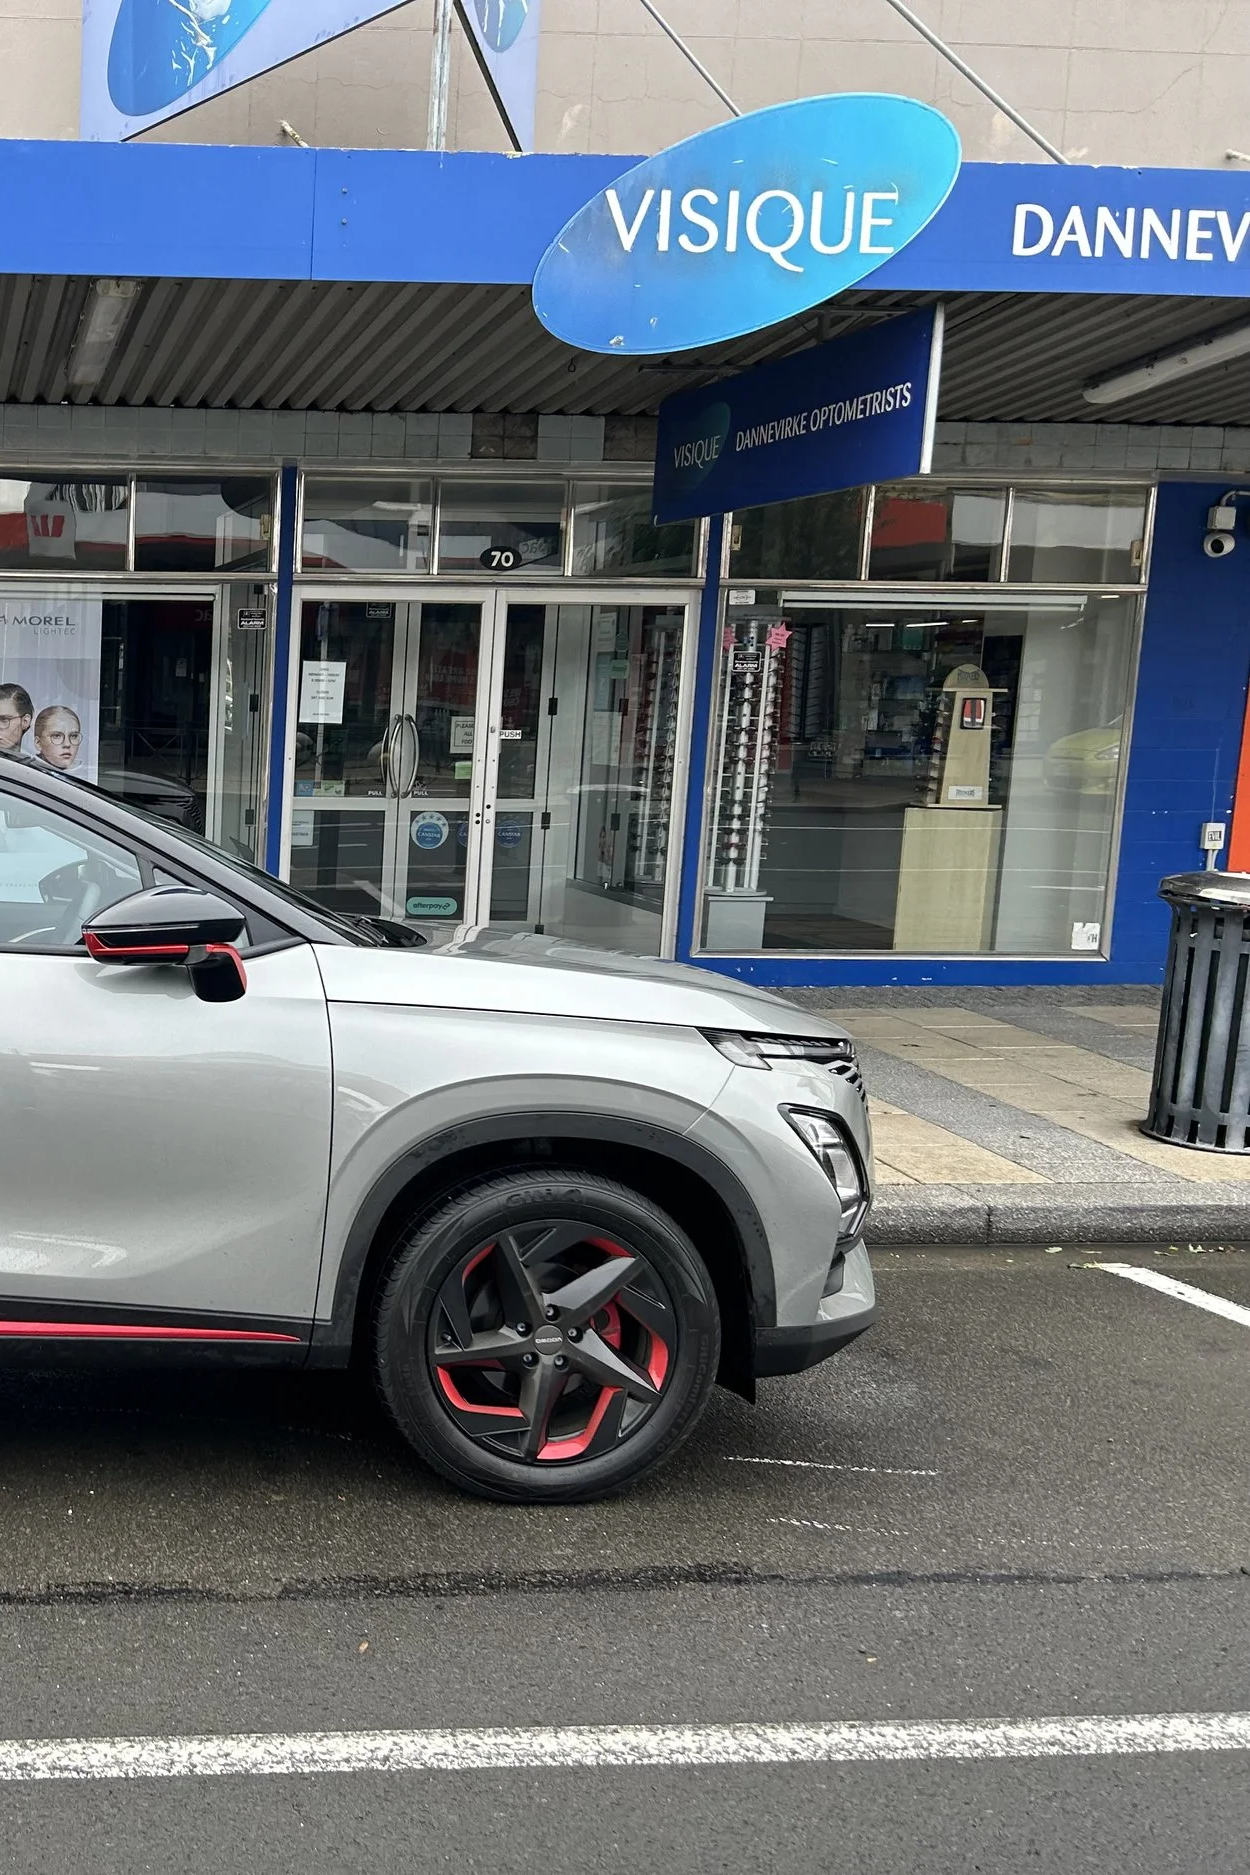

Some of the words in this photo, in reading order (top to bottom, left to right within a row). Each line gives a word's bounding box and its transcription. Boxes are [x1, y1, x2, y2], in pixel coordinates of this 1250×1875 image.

[606, 188, 894, 271] VISIQUE
[1012, 203, 1250, 262] DANNEV
[674, 435, 720, 469] VISIQUE
[736, 408, 806, 451] DANNEVIRKE
[810, 381, 911, 431] OPTOMETRISTS
[490, 551, 514, 567] 70
[12, 616, 76, 626] MOREL
[34, 627, 76, 636] LIGHTEC
[499, 730, 521, 738] PUSH
[412, 902, 442, 910] afterpay
